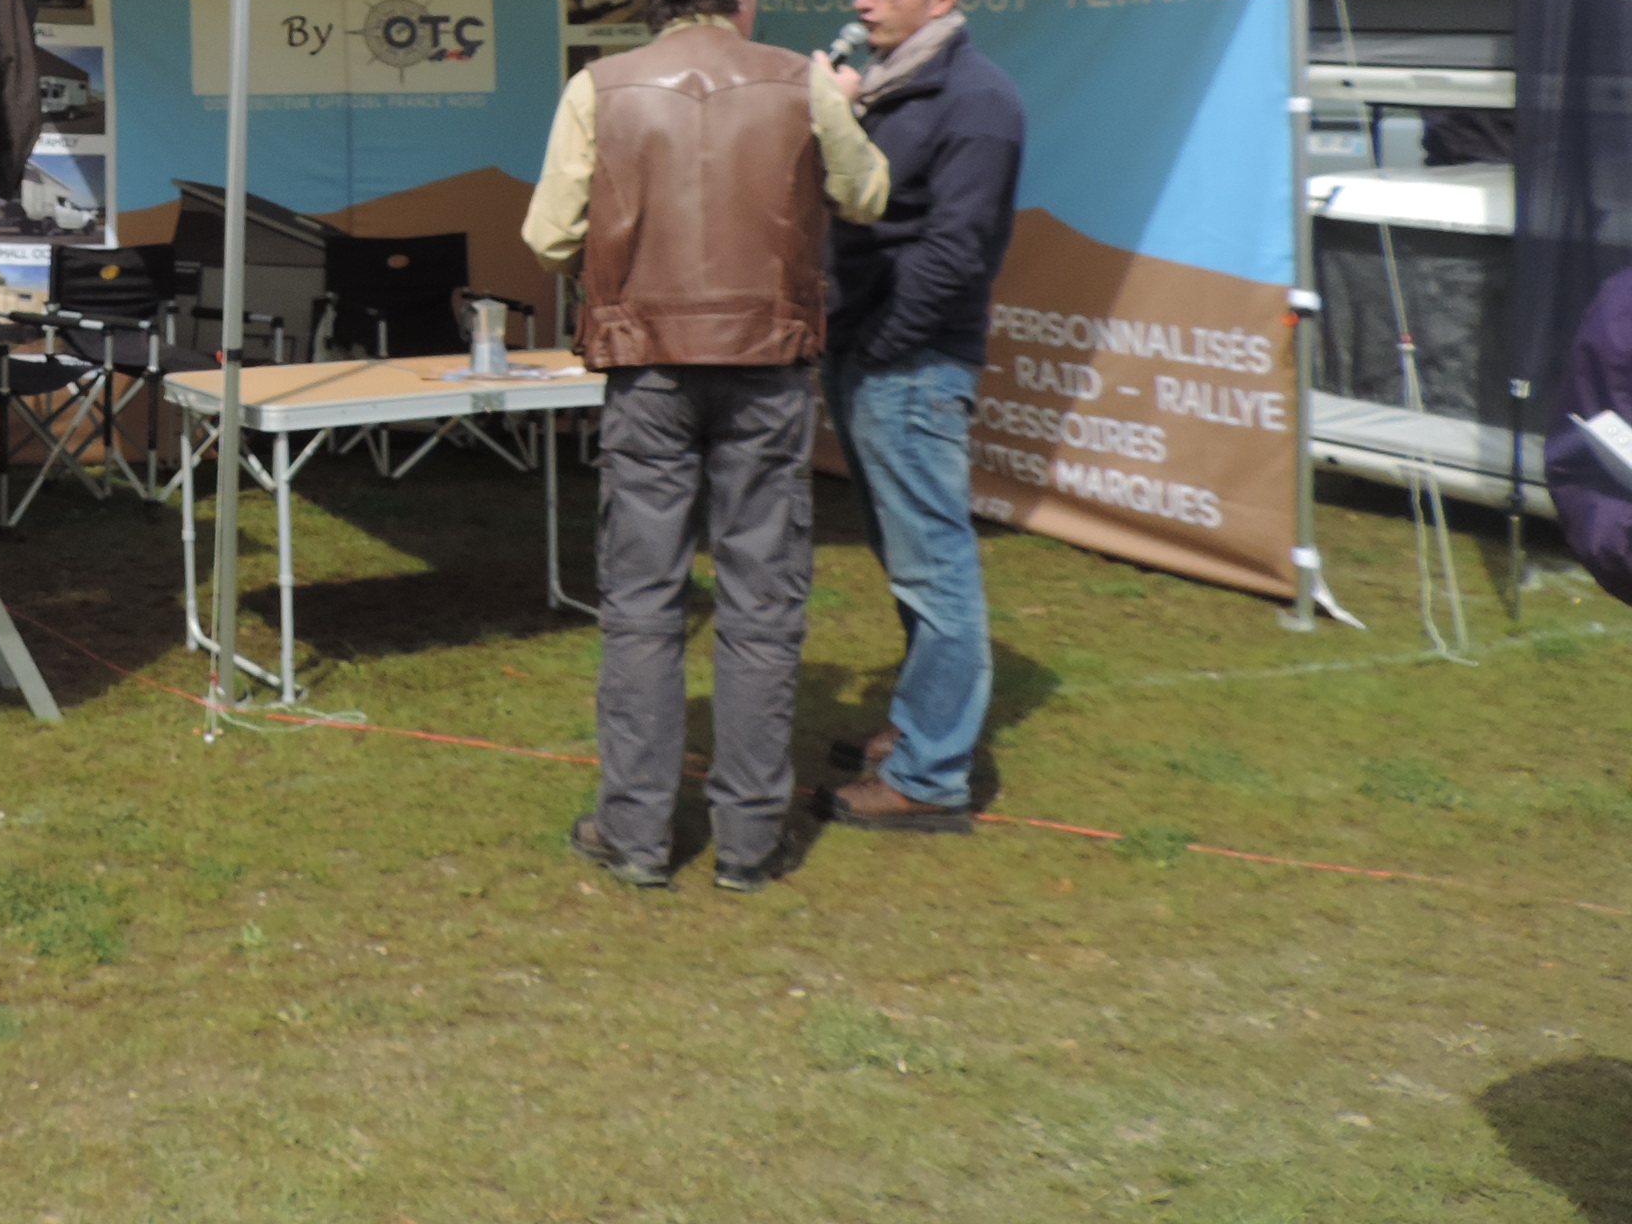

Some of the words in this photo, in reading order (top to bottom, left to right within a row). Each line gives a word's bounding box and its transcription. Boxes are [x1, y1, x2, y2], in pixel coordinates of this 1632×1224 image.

[282, 15, 334, 56] By
[384, 15, 485, 50] OTC
[990, 303, 1273, 374] PERSONNALISÉS
[1014, 355, 1103, 401] RAID
[1153, 374, 1288, 432] RALLYE
[972, 396, 1167, 463] CESSOIRES
[1055, 459, 1223, 529] MARQUES
